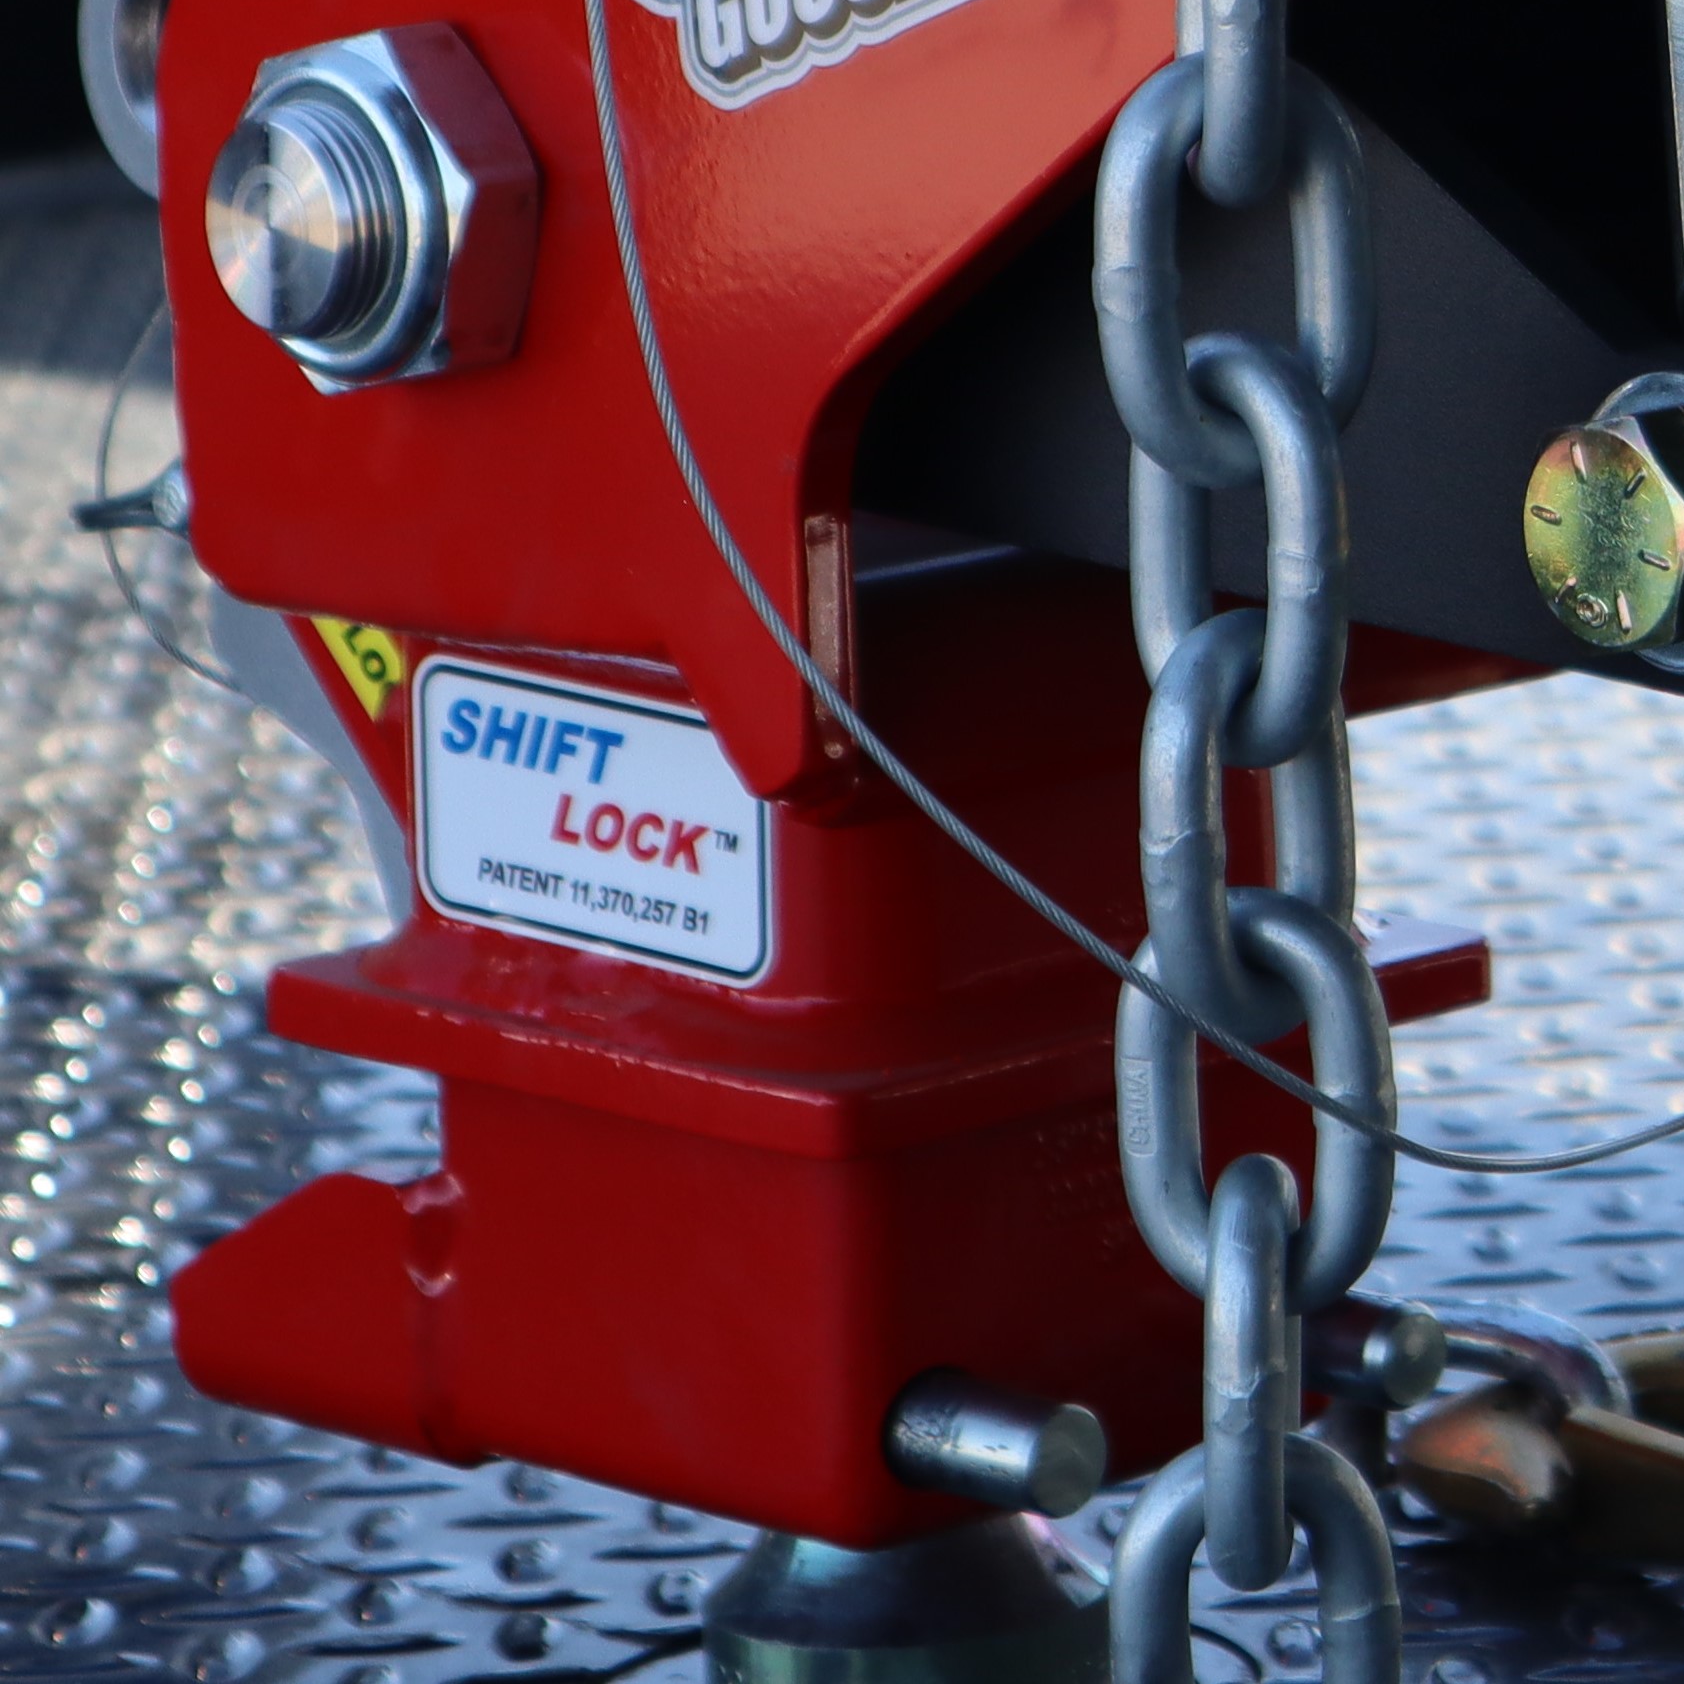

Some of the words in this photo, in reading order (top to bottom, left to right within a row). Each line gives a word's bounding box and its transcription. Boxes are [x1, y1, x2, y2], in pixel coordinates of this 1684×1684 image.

[441, 697, 625, 785] SHIFT
[477, 857, 565, 899] PATENT
[570, 879, 678, 926] 11,370,257
[681, 906, 710, 934] B1
